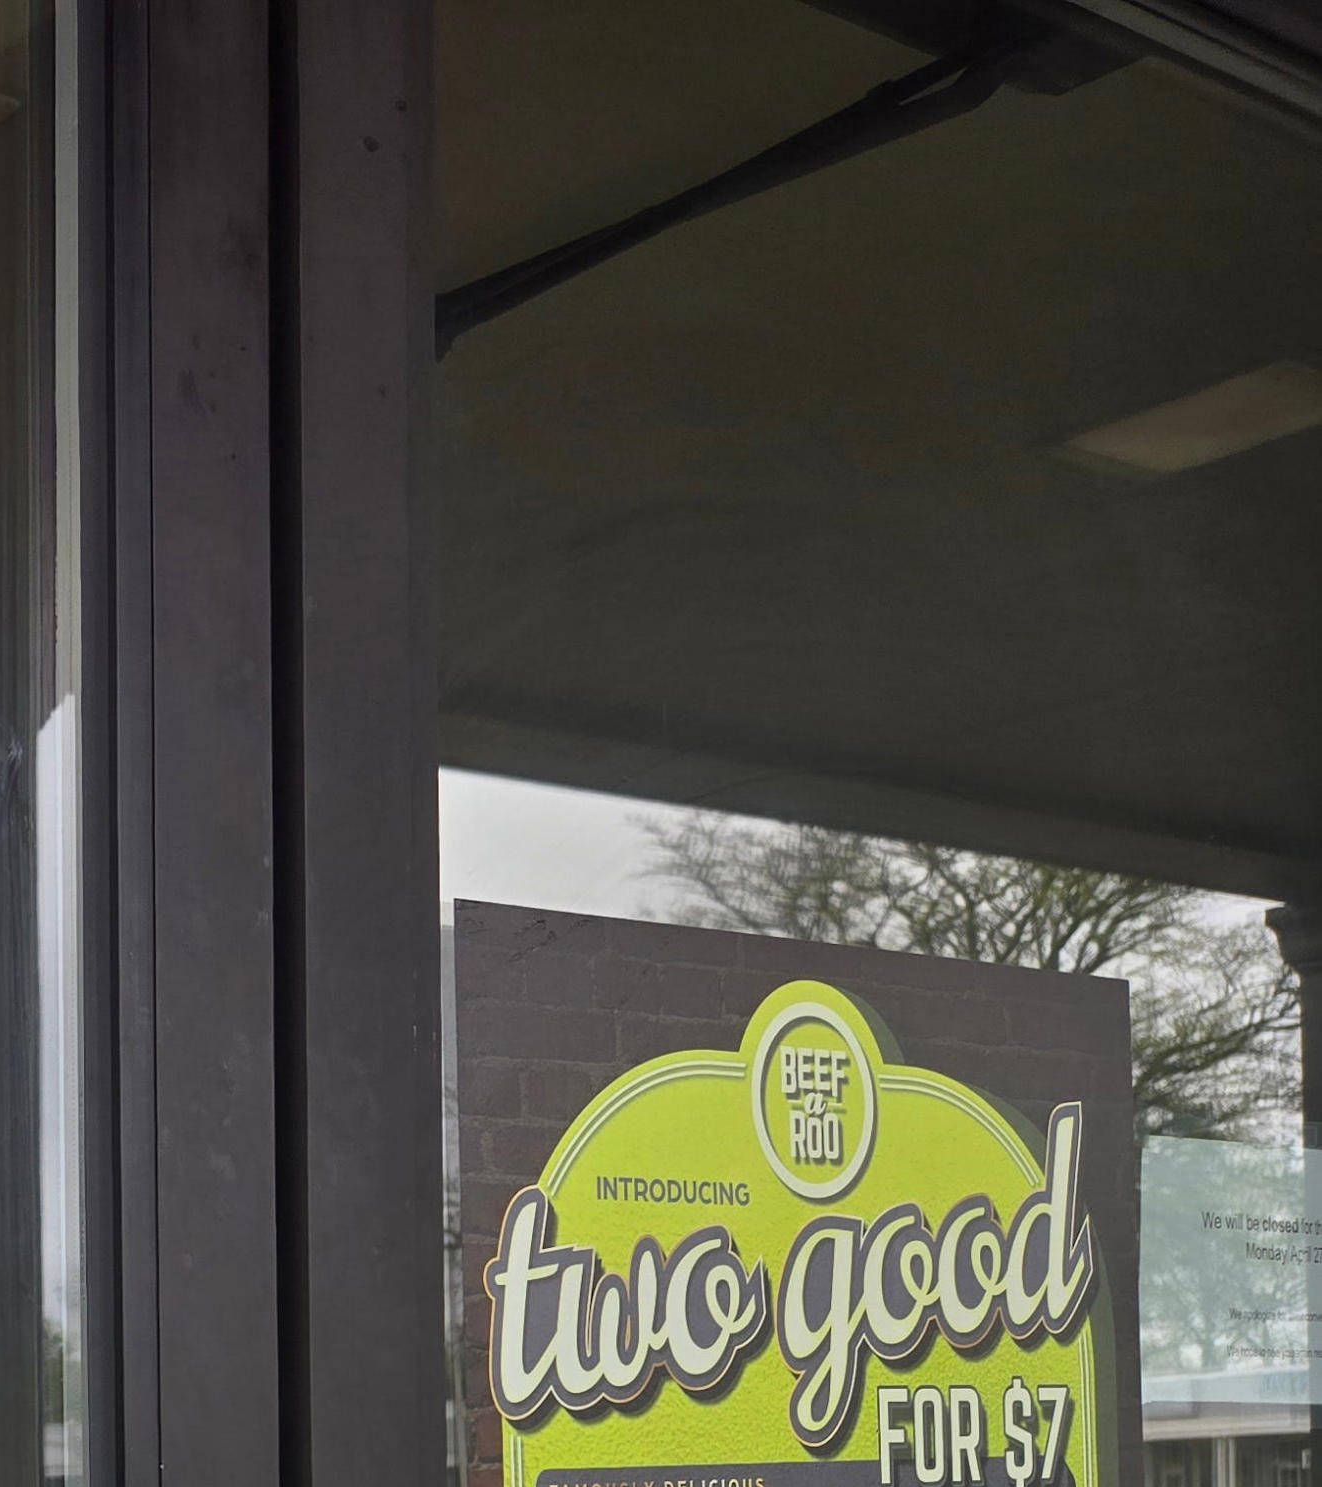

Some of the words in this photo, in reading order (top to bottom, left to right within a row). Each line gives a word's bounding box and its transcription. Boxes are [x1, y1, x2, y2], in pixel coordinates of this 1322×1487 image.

[779, 1045, 847, 1098] BEEF
[803, 1092, 827, 1115] a
[788, 1110, 840, 1160] ROO
[596, 1176, 751, 1206] INTRODUCING
[1201, 1211, 1222, 1229] We
[1245, 1213, 1259, 1231] be
[1262, 1215, 1299, 1233] closed
[493, 1198, 759, 1406] two
[782, 1112, 1086, 1434] good
[1245, 1241, 1287, 1265] Monday
[877, 1386, 981, 1485] FOR
